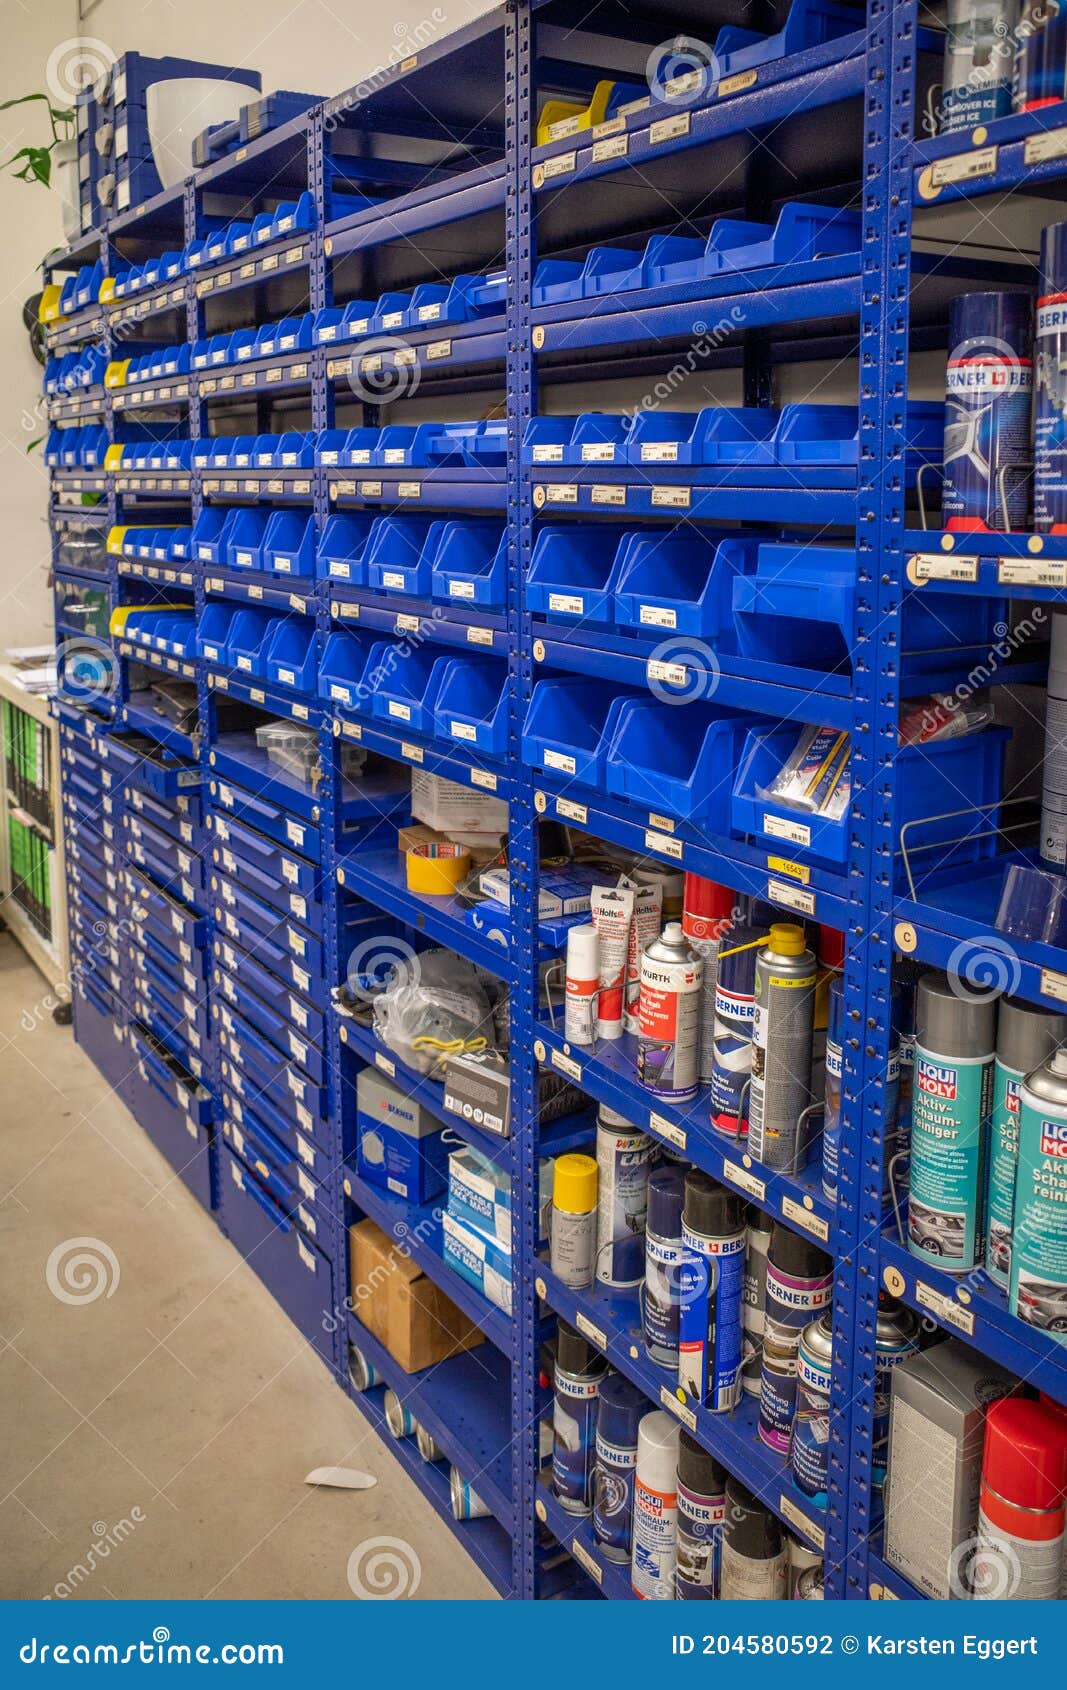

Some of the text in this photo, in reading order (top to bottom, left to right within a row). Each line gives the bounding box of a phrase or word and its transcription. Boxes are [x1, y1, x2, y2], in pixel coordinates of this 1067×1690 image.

[903, 932, 911, 943] C
[716, 997, 754, 1017] BERNER
[918, 1061, 955, 1084] LIQUI
[917, 1075, 956, 1098] MOLY
[917, 1092, 953, 1113] Aktiv-
[913, 1103, 961, 1127] Schaum-
[913, 1117, 959, 1140] reiniger
[767, 1277, 809, 1306] BERNER
[892, 1275, 899, 1287] D
